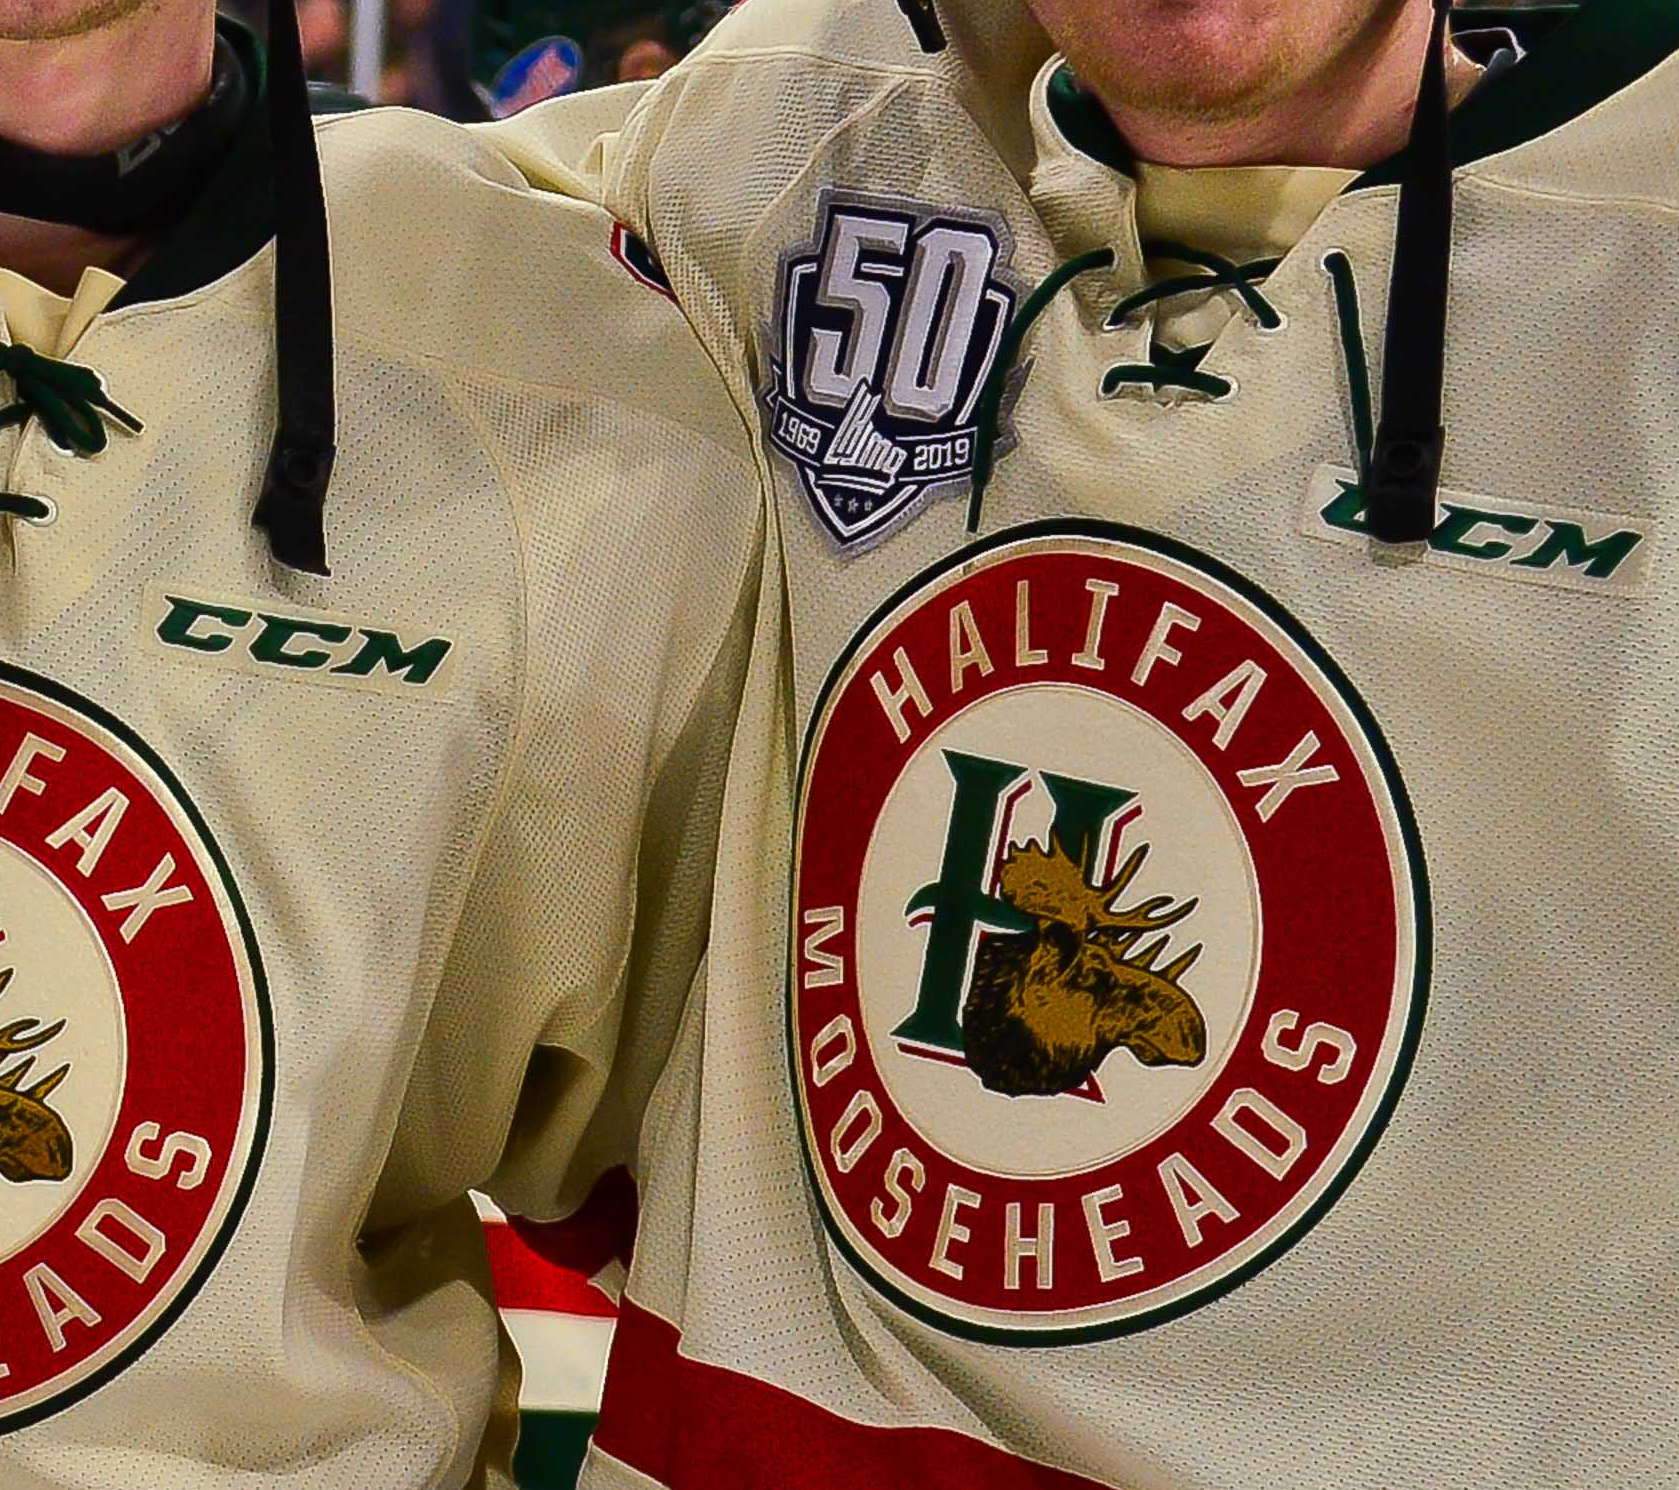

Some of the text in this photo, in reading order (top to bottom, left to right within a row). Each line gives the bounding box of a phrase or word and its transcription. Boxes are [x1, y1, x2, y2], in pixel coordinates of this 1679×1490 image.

[802, 213, 993, 422] 50
[777, 410, 820, 454] 1969
[913, 435, 970, 472] 2019
[1319, 478, 1644, 579] CCM
[155, 592, 453, 685] CCM
[869, 577, 1341, 823] HALIFAX
[802, 904, 1357, 1291] MOOSEHEADS
